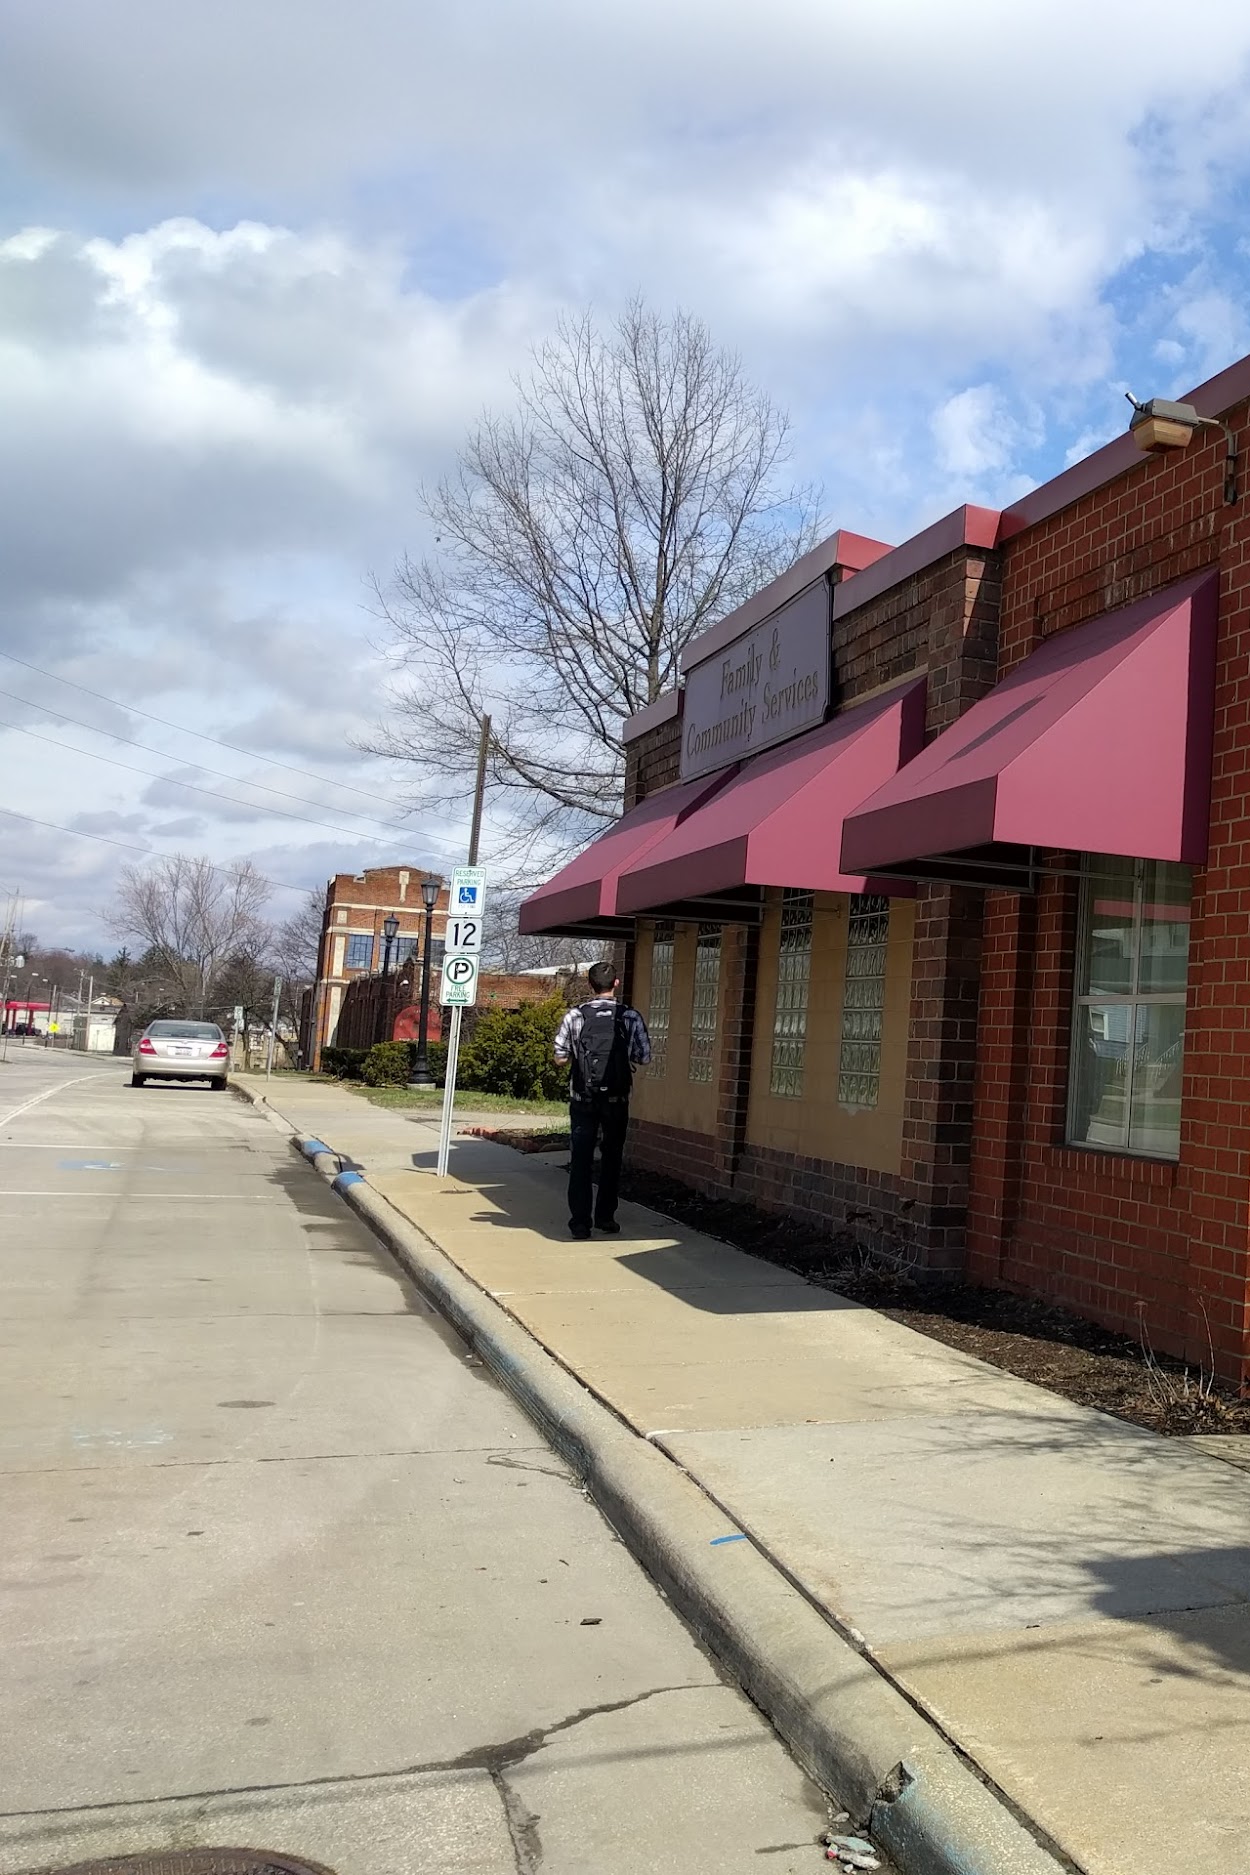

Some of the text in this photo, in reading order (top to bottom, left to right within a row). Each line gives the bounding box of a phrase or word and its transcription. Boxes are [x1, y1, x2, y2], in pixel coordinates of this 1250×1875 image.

[720, 628, 780, 700] Family &
[687, 668, 819, 758] Community Services
[455, 869, 484, 877] RESERVED
[454, 922, 476, 946] 12
[454, 962, 469, 980] P
[451, 984, 466, 992] FREE
